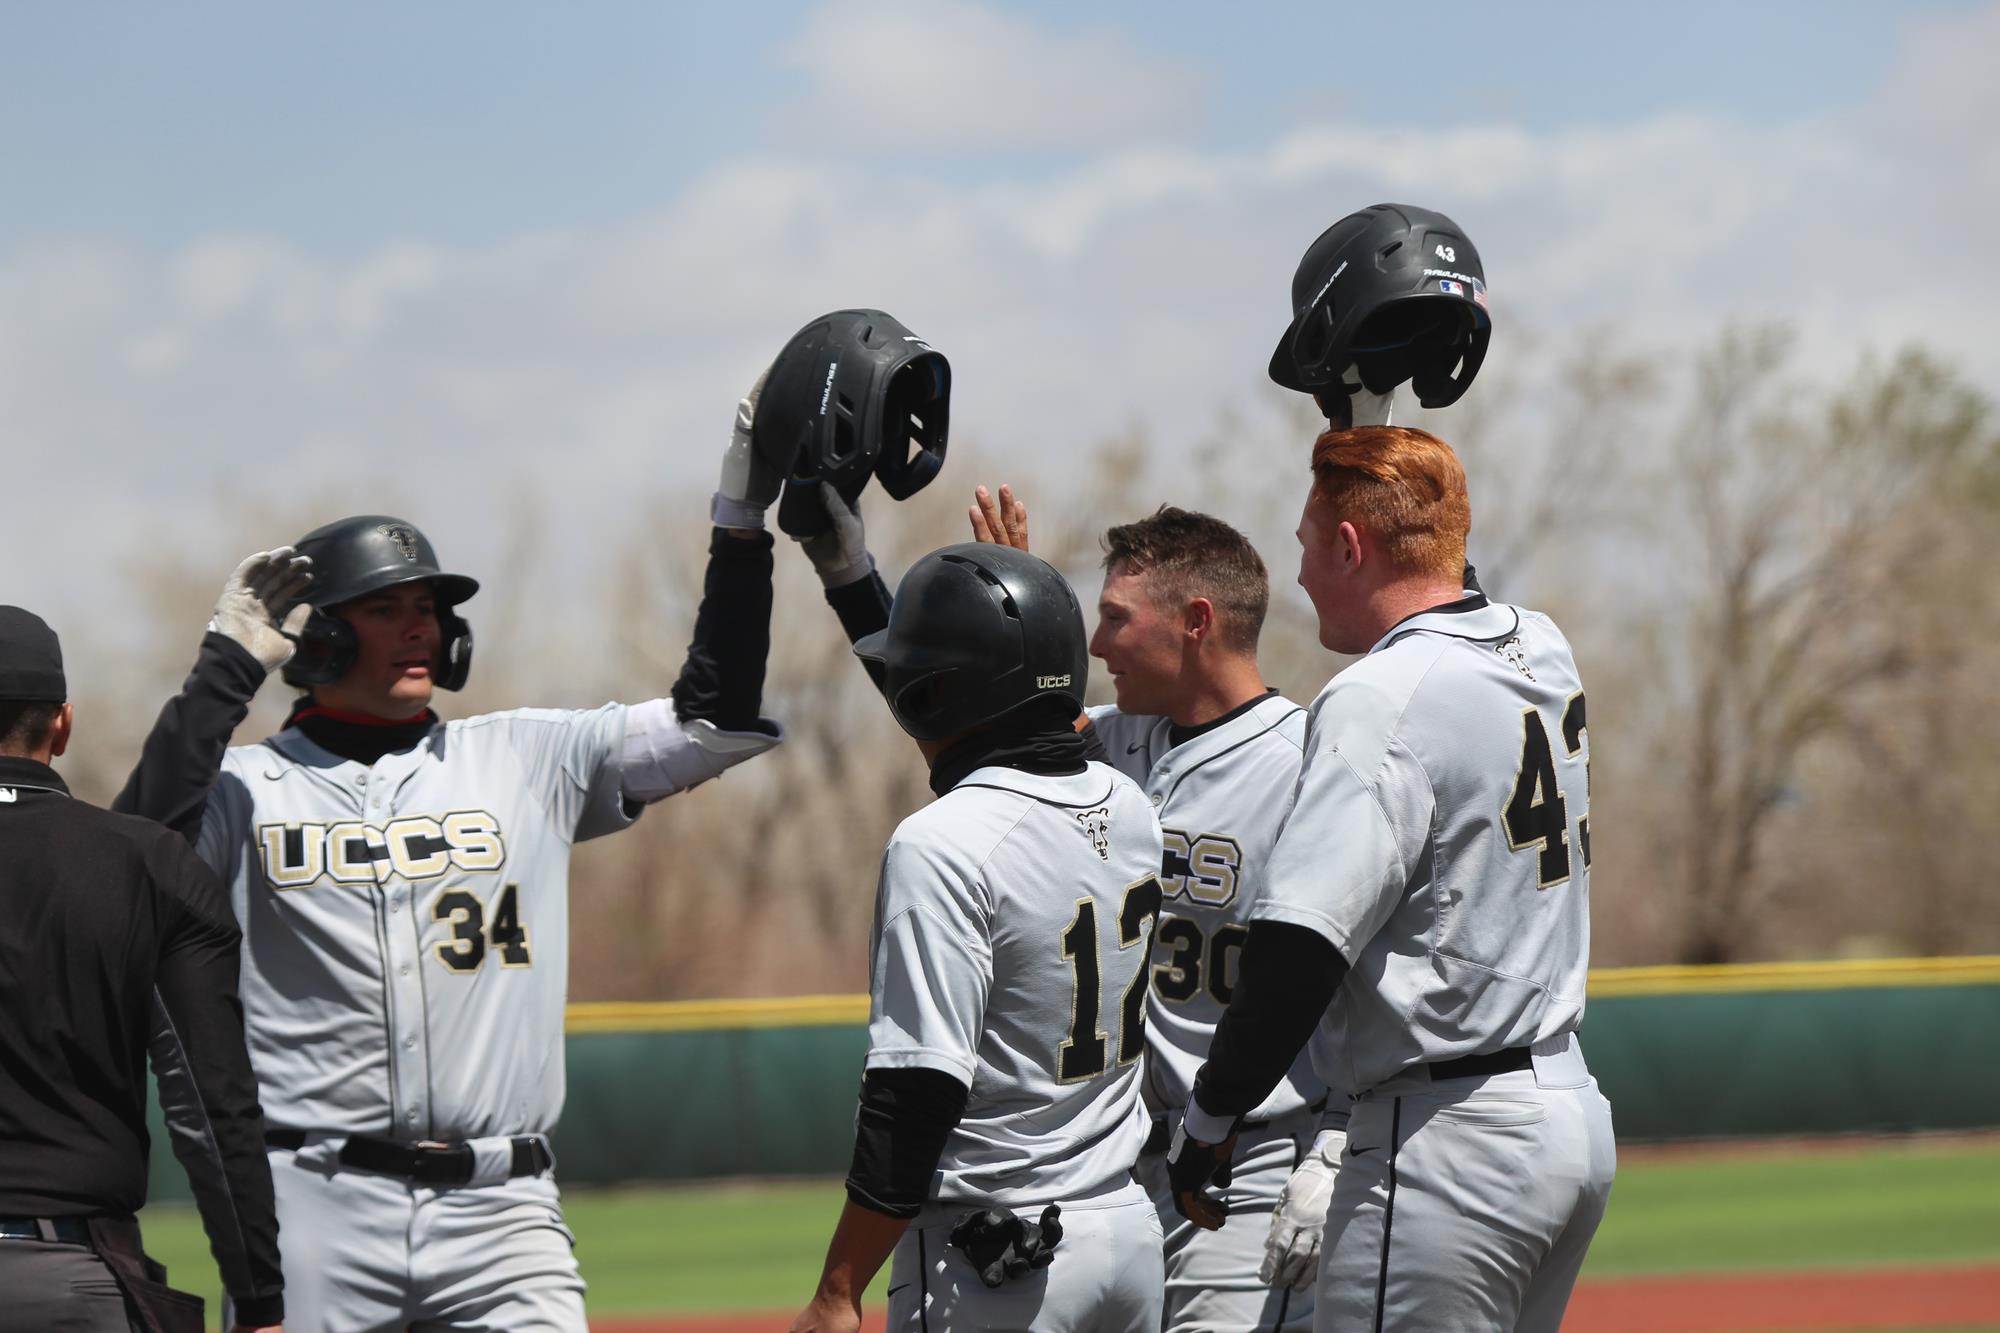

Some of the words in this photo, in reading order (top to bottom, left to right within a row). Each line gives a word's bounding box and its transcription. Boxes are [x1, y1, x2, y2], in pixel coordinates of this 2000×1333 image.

[1435, 244, 1456, 263] 43
[1036, 674, 1071, 689] UCCS
[257, 809, 505, 891] UCCS
[431, 881, 532, 974] 34
[1151, 916, 1249, 1005] 30
[1056, 872, 1163, 1085] 12
